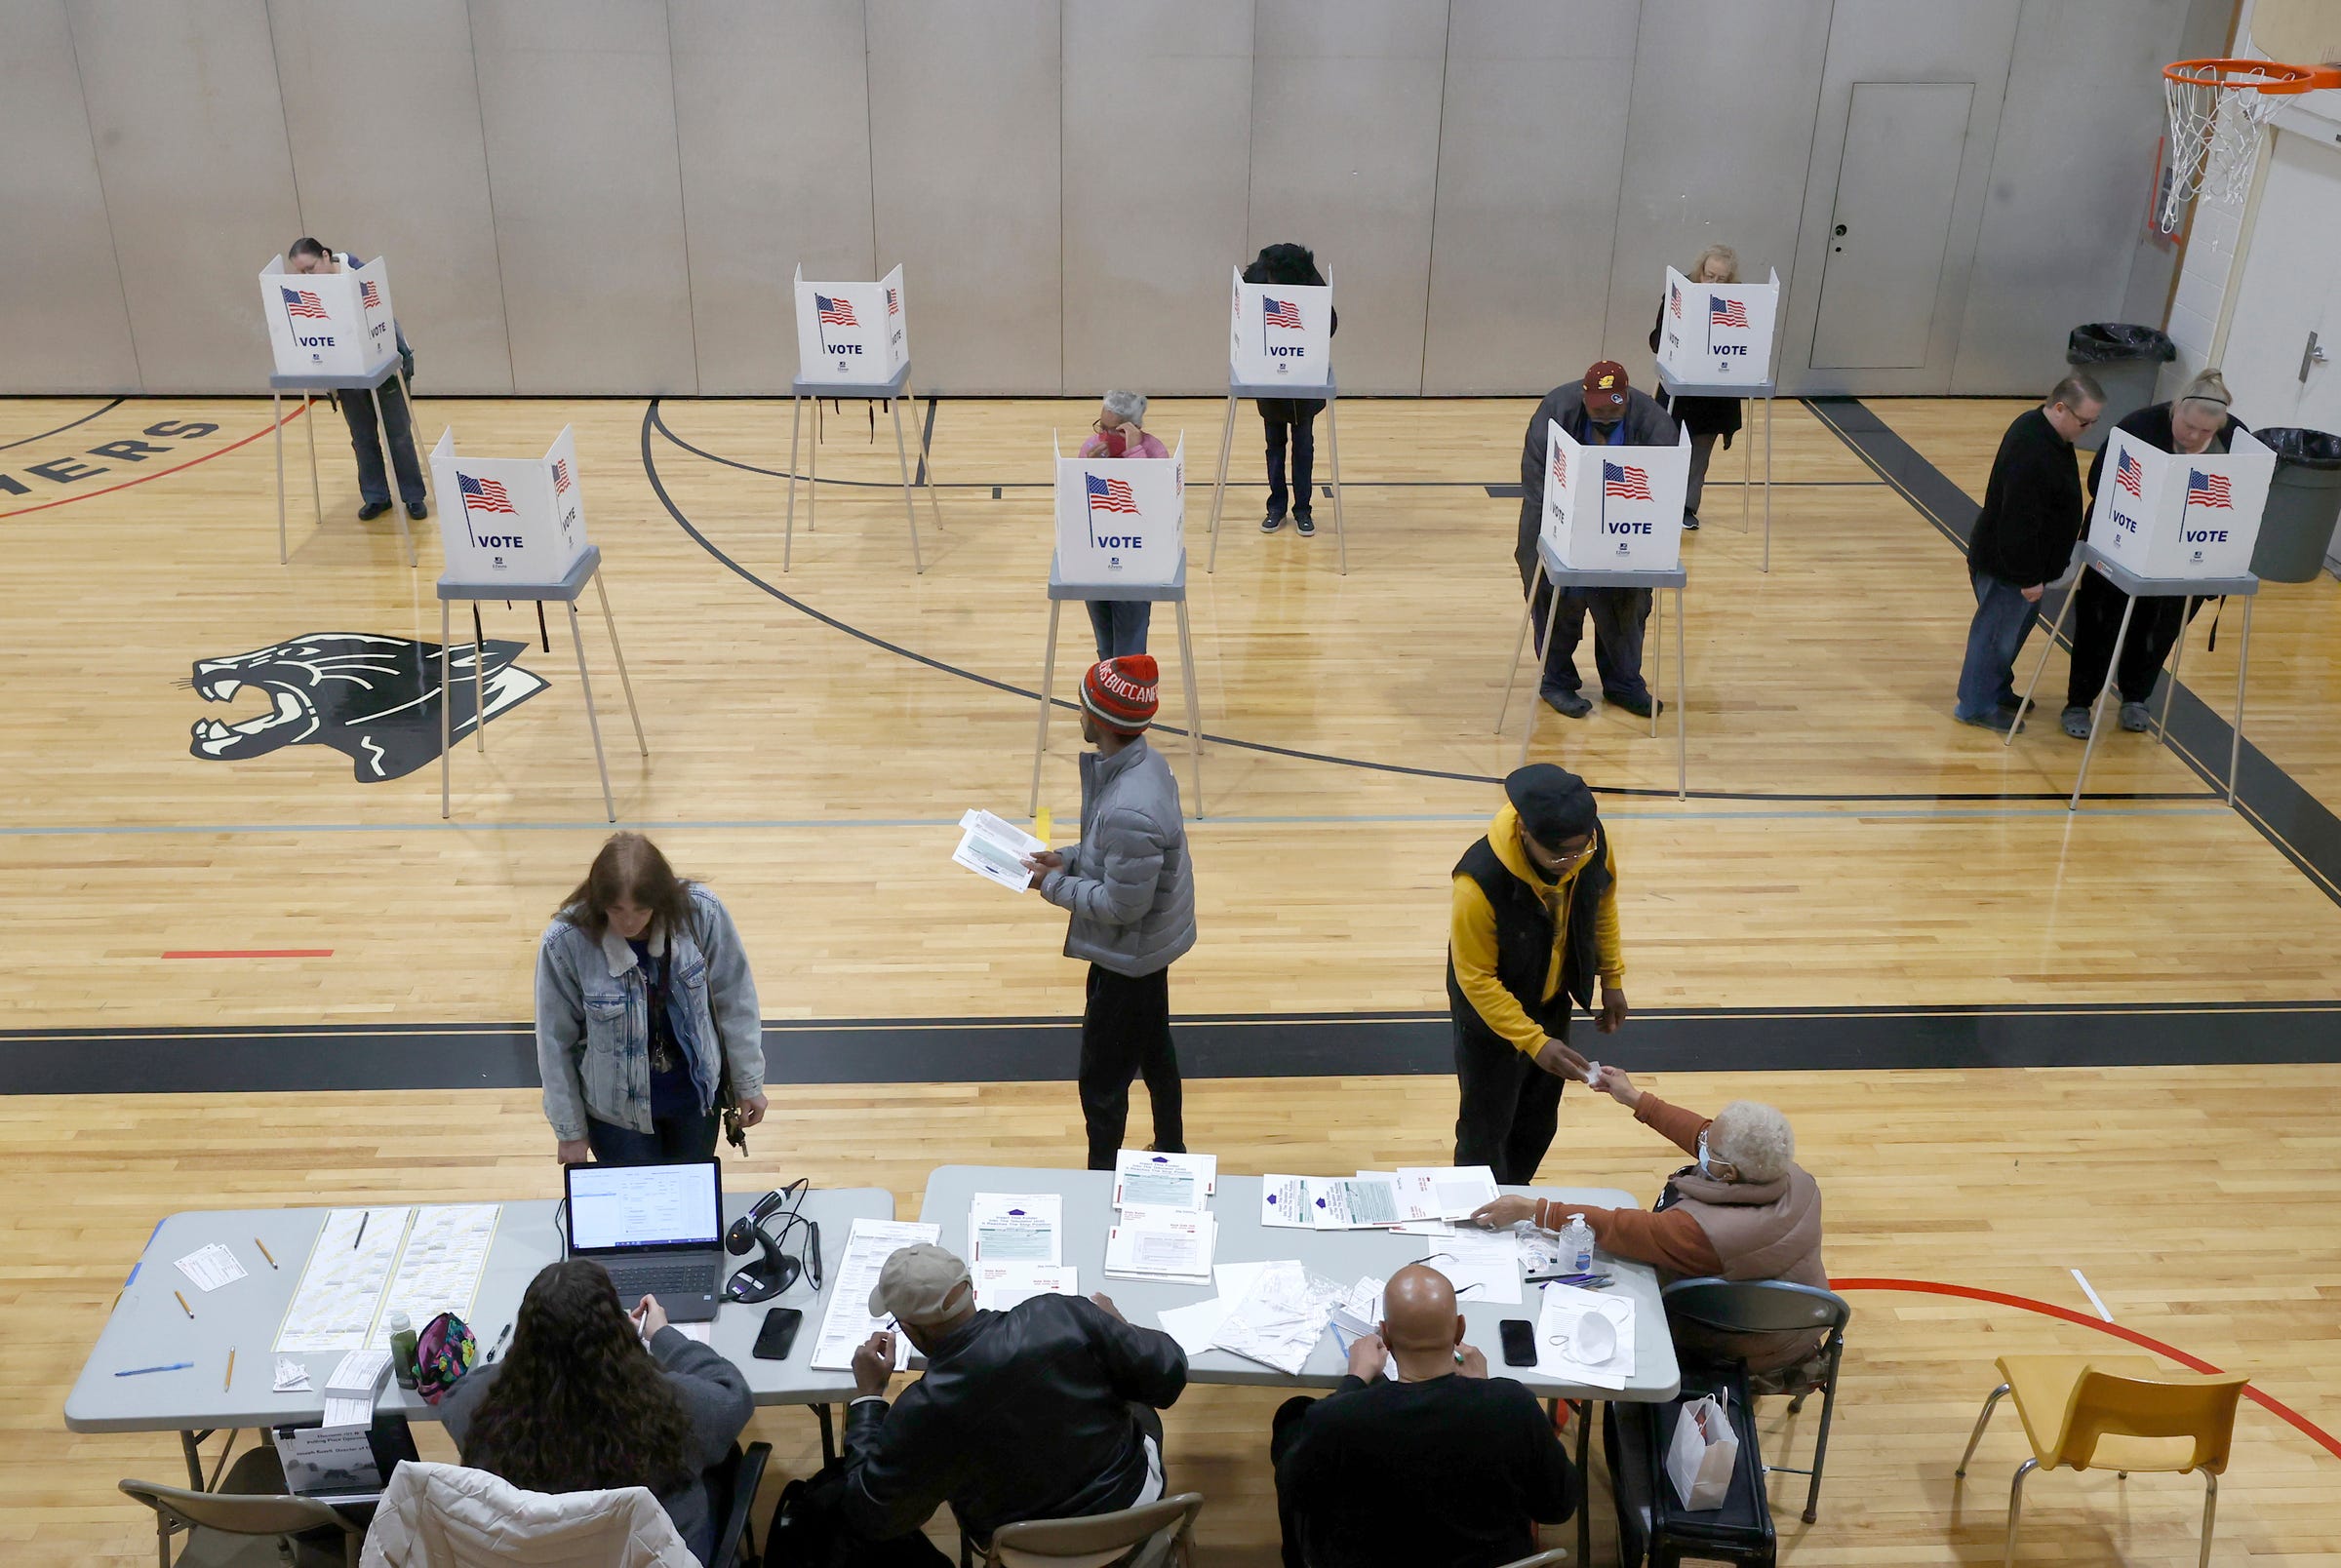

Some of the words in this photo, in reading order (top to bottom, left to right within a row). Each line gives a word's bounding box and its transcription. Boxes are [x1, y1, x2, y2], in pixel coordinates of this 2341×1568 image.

[370, 322, 386, 338] VOTE
[299, 337, 336, 347] VOTE
[828, 344, 862, 354] VOTE
[1270, 346, 1305, 357] VOTE
[1713, 345, 1747, 355] VOTE
[2113, 510, 2137, 533] VOTE
[1608, 523, 1652, 534] VOTE
[2186, 530, 2229, 542] VOTE
[478, 536, 524, 548] VOTE
[1097, 536, 1142, 549] VOTE
